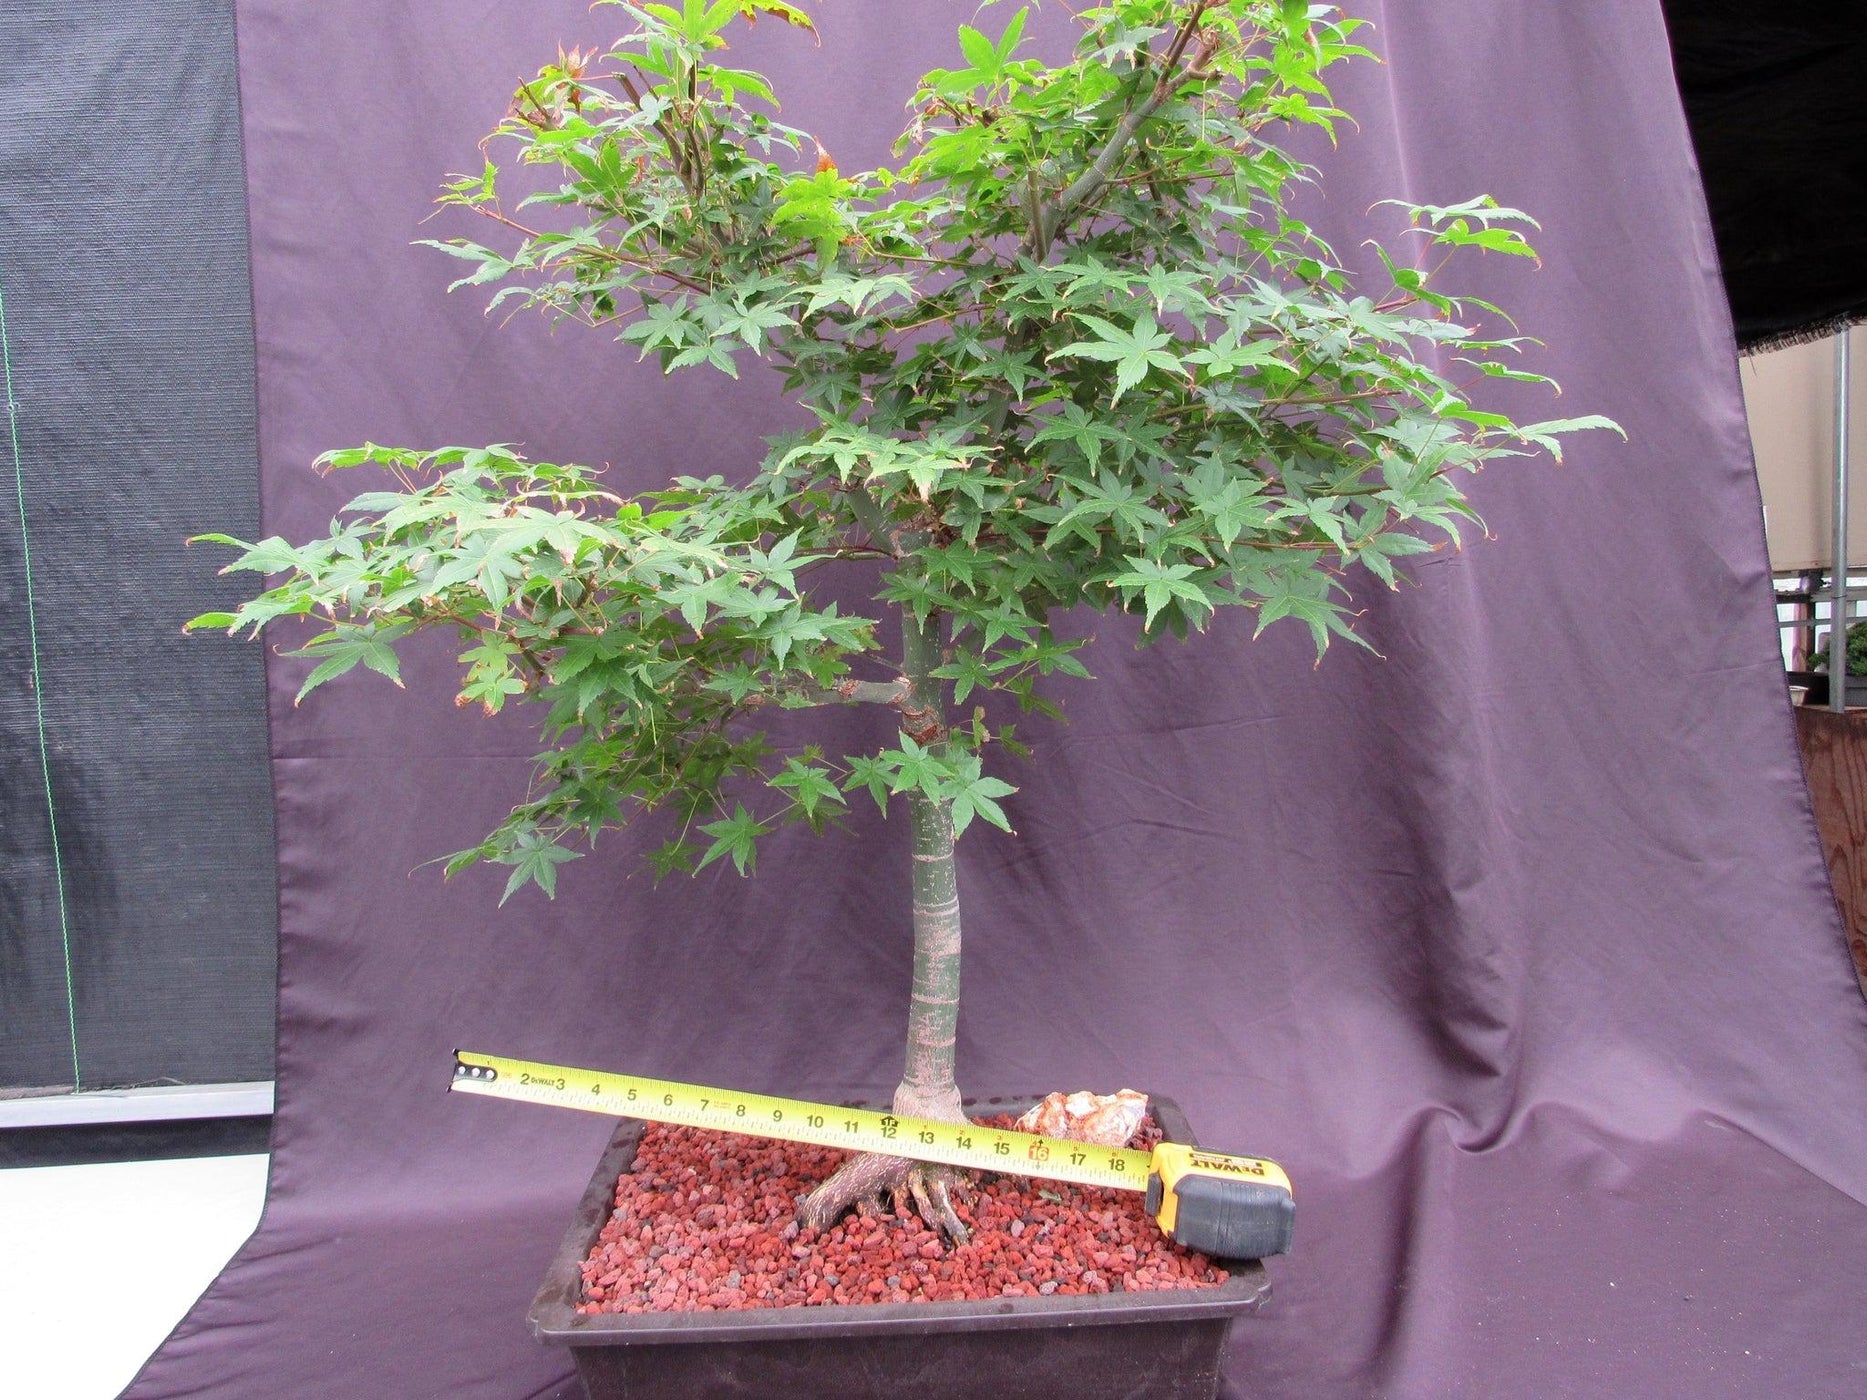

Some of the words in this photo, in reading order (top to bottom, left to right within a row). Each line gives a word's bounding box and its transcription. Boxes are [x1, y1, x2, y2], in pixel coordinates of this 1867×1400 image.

[520, 1073, 530, 1086] 2
[555, 1078, 566, 1091] 3
[591, 1083, 601, 1096] 4
[627, 1088, 637, 1101] 5
[663, 1094, 673, 1106] 6
[700, 1099, 710, 1111] 7
[736, 1104, 746, 1117] 8
[773, 1110, 783, 1122] 9
[806, 1114, 824, 1128] 10
[844, 1120, 859, 1133] 11
[880, 1126, 897, 1139] 12
[918, 1131, 935, 1144] 13
[956, 1136, 972, 1150] 14
[993, 1142, 1010, 1155] 15
[1030, 1146, 1048, 1160] 16
[1069, 1153, 1087, 1166] 17
[1108, 1158, 1125, 1172] 18
[1190, 1159, 1265, 1177] DEWALT
